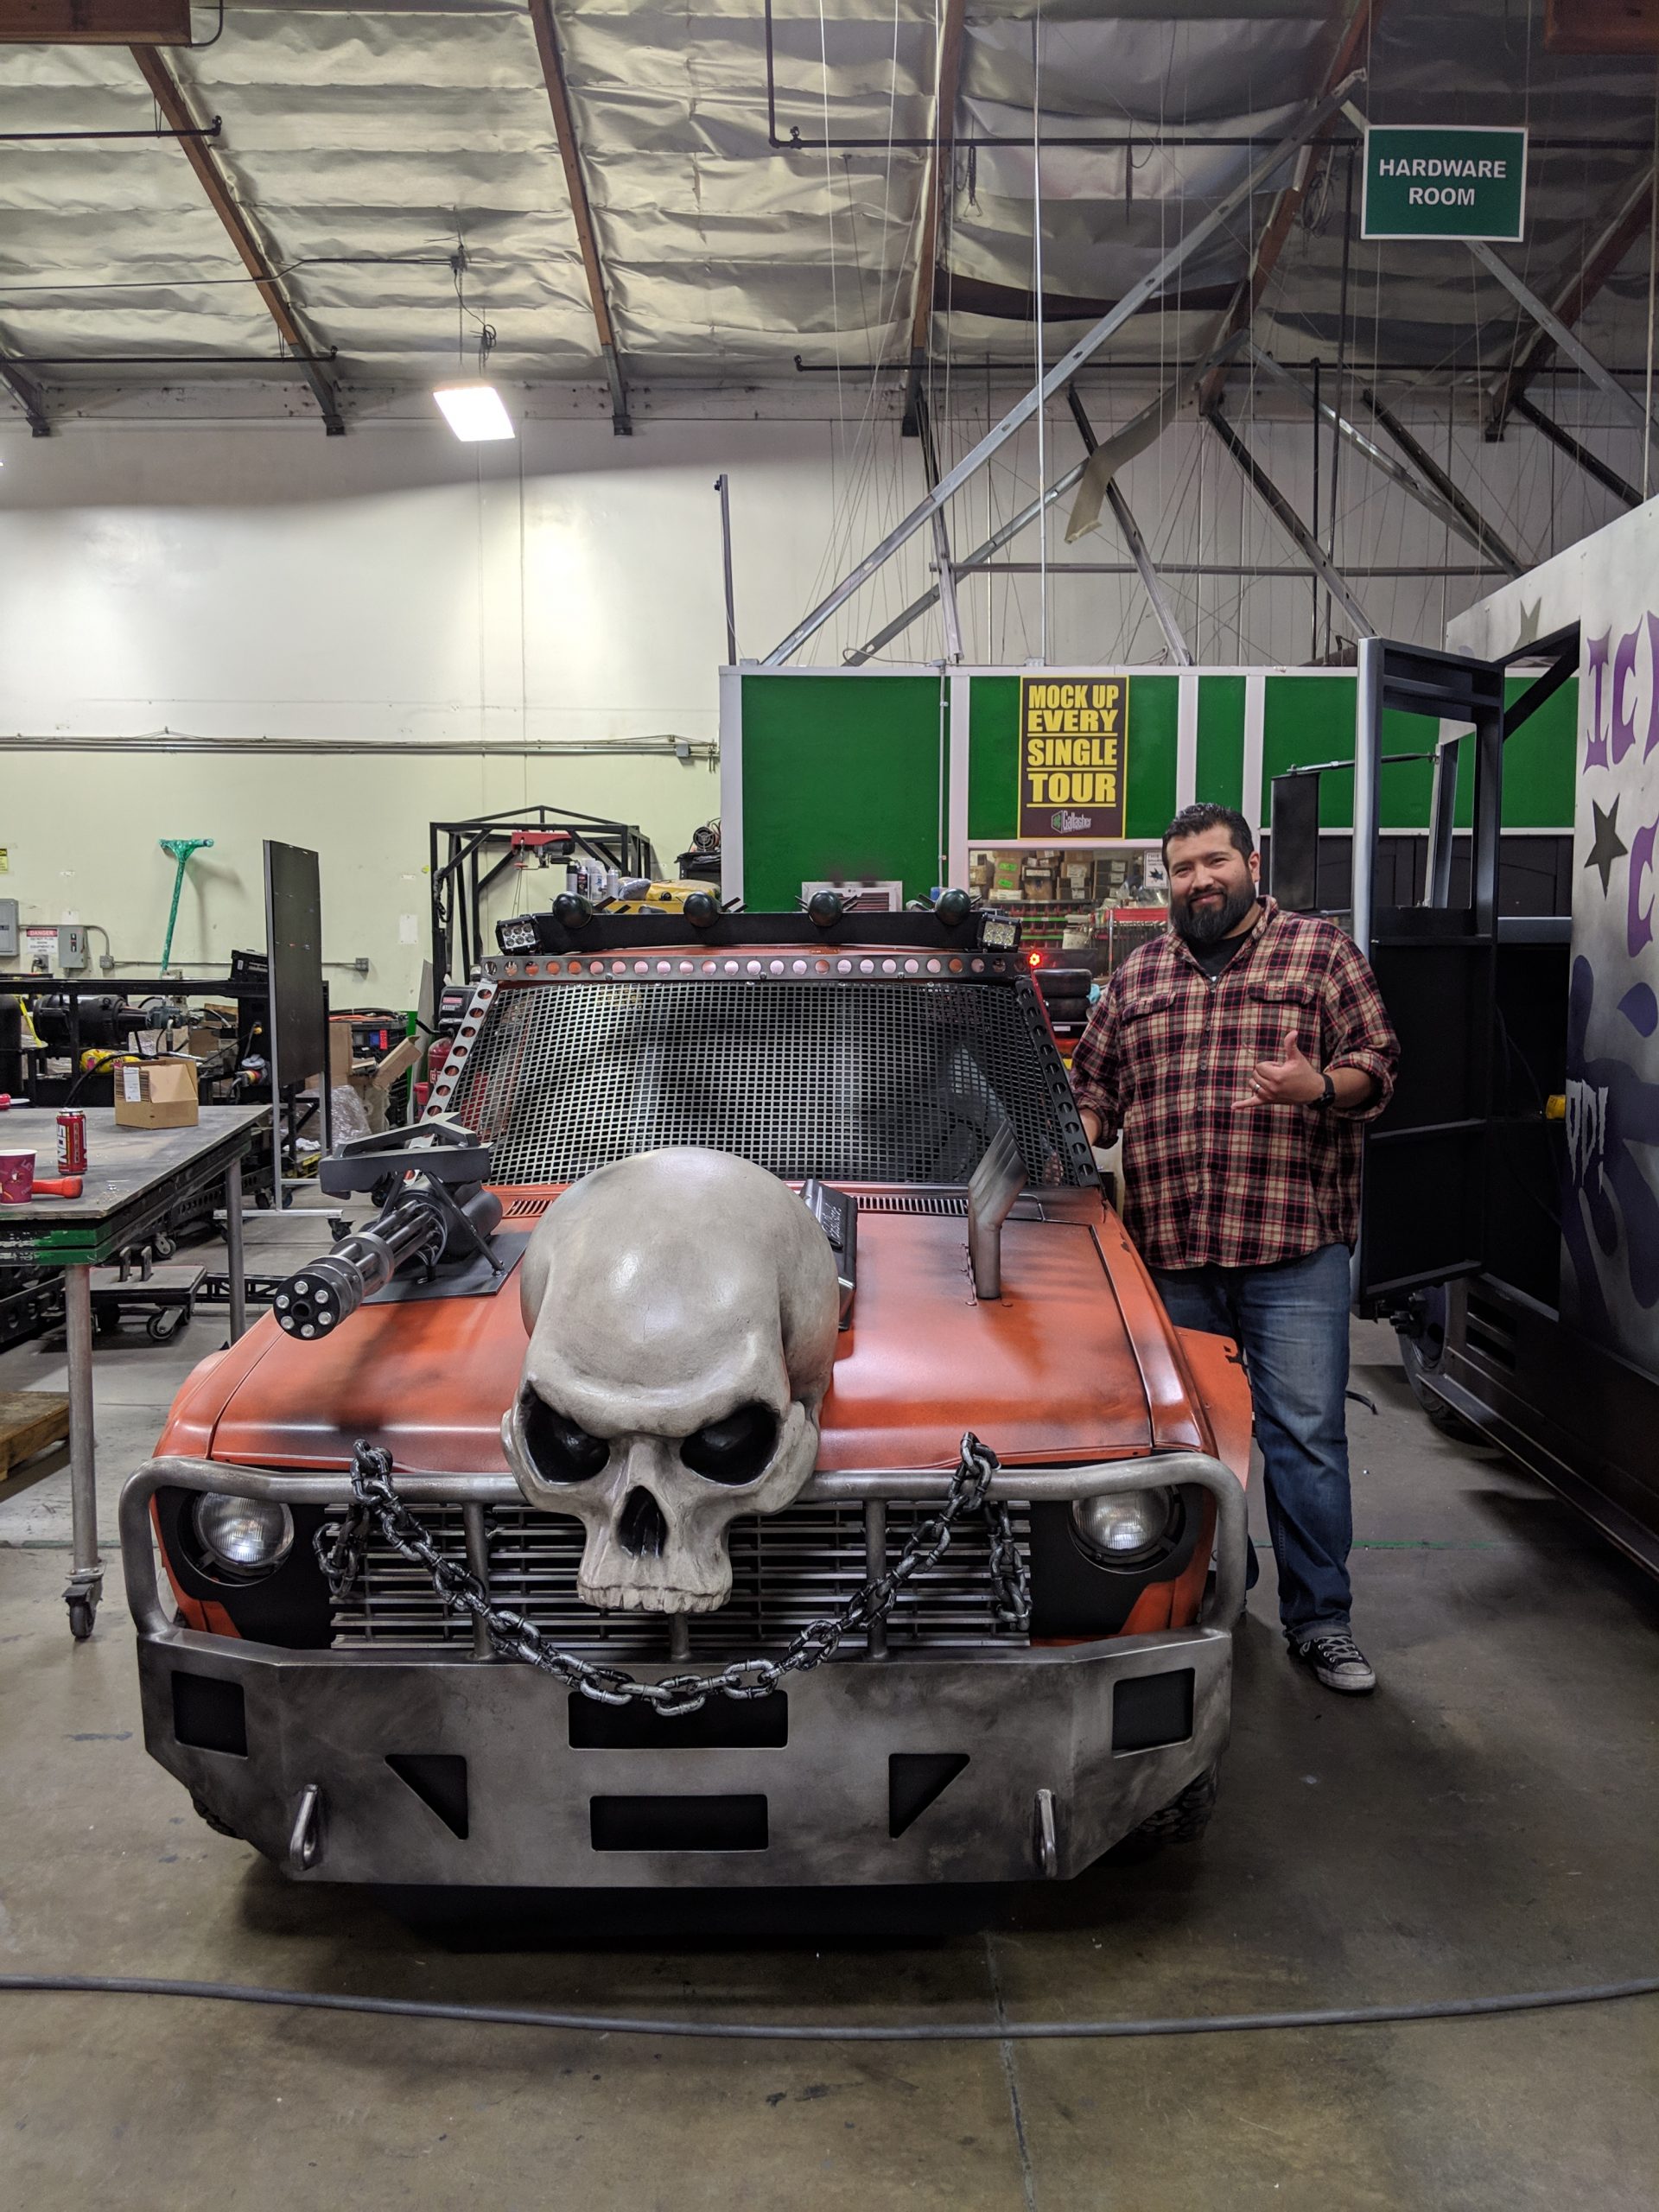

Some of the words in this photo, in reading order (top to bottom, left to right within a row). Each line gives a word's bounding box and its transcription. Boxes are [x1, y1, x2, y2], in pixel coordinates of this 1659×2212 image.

[1379, 159, 1506, 178] HARDWARE
[1408, 187, 1475, 206] ROOM
[1028, 684, 1089, 709] MOCK
[1092, 684, 1119, 709] UP
[1027, 709, 1118, 732] EVERY
[1027, 739, 1117, 766] SINGLE
[1027, 773, 1116, 802] TOUR
